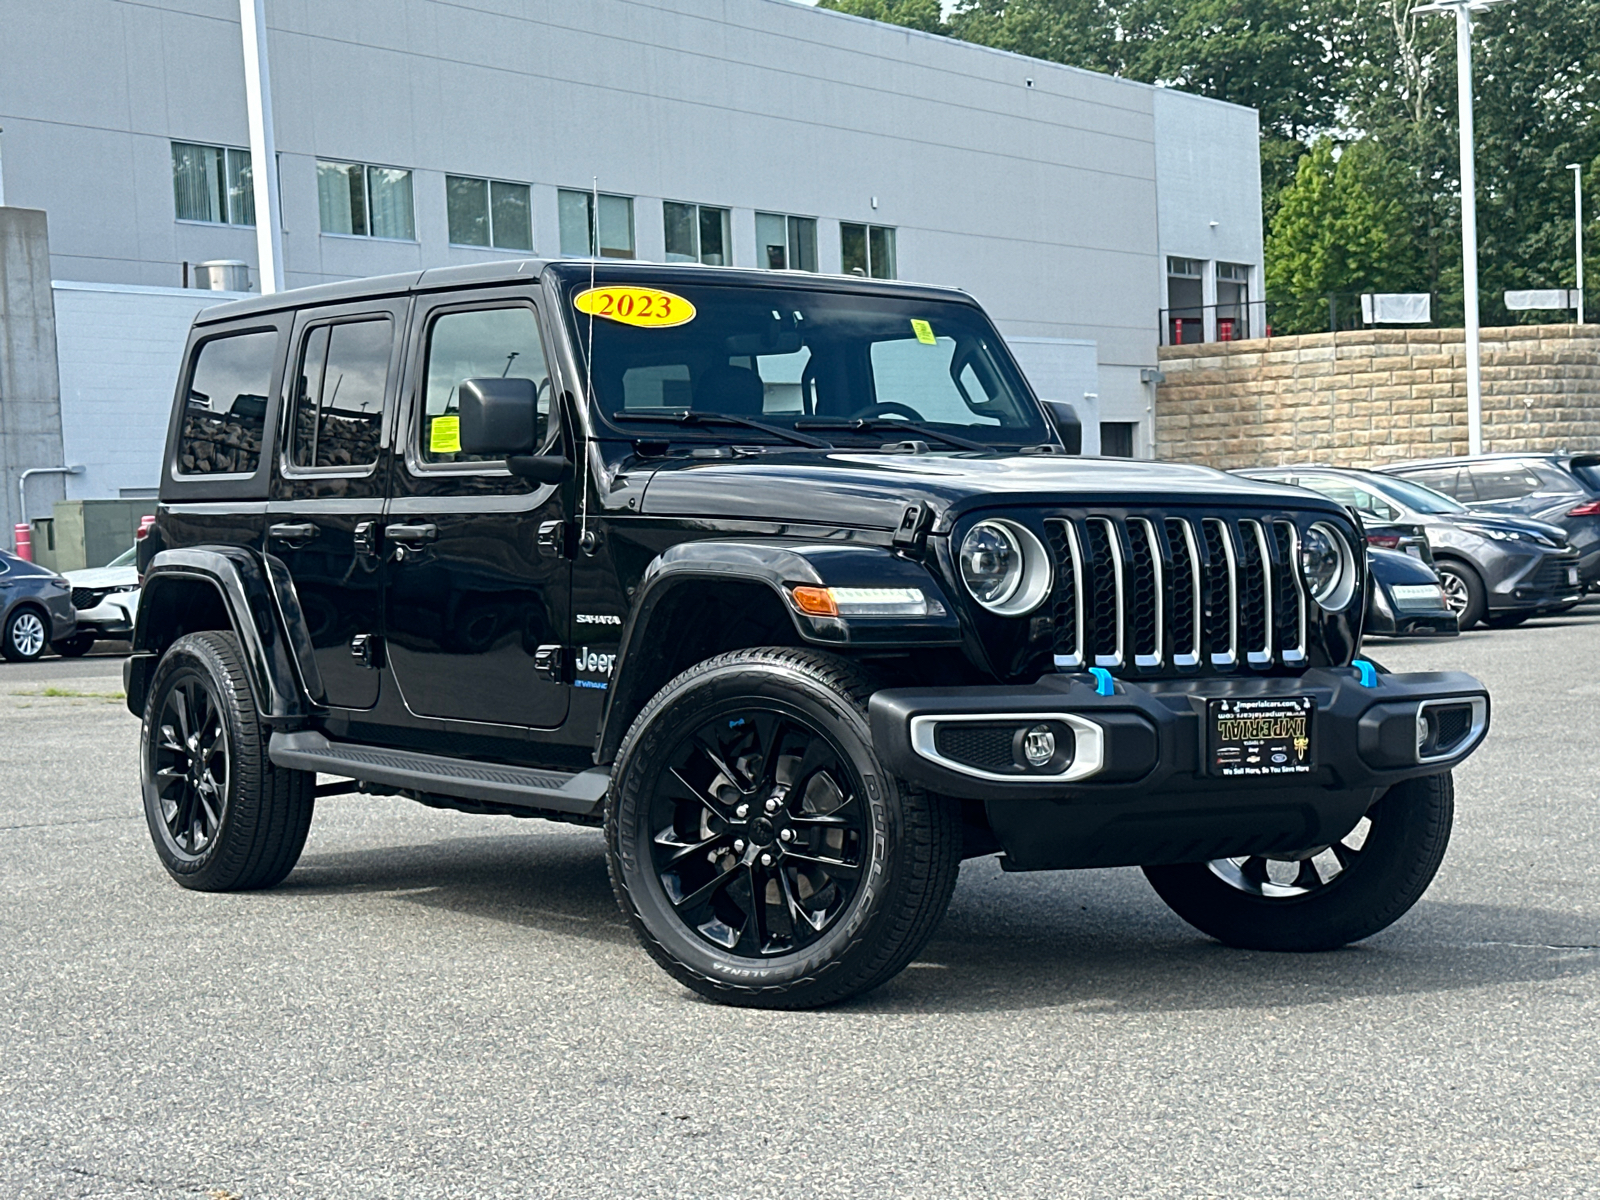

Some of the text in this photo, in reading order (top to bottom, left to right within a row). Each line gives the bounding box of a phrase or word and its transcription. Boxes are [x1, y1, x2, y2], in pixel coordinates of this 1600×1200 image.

[599, 294, 671, 318] 2023
[576, 614, 621, 625] SAHARA
[576, 646, 616, 678] Jeep
[1218, 718, 1306, 740] IMPERIAL
[847, 774, 889, 937] DUELER
[712, 961, 770, 978] ALENZA
